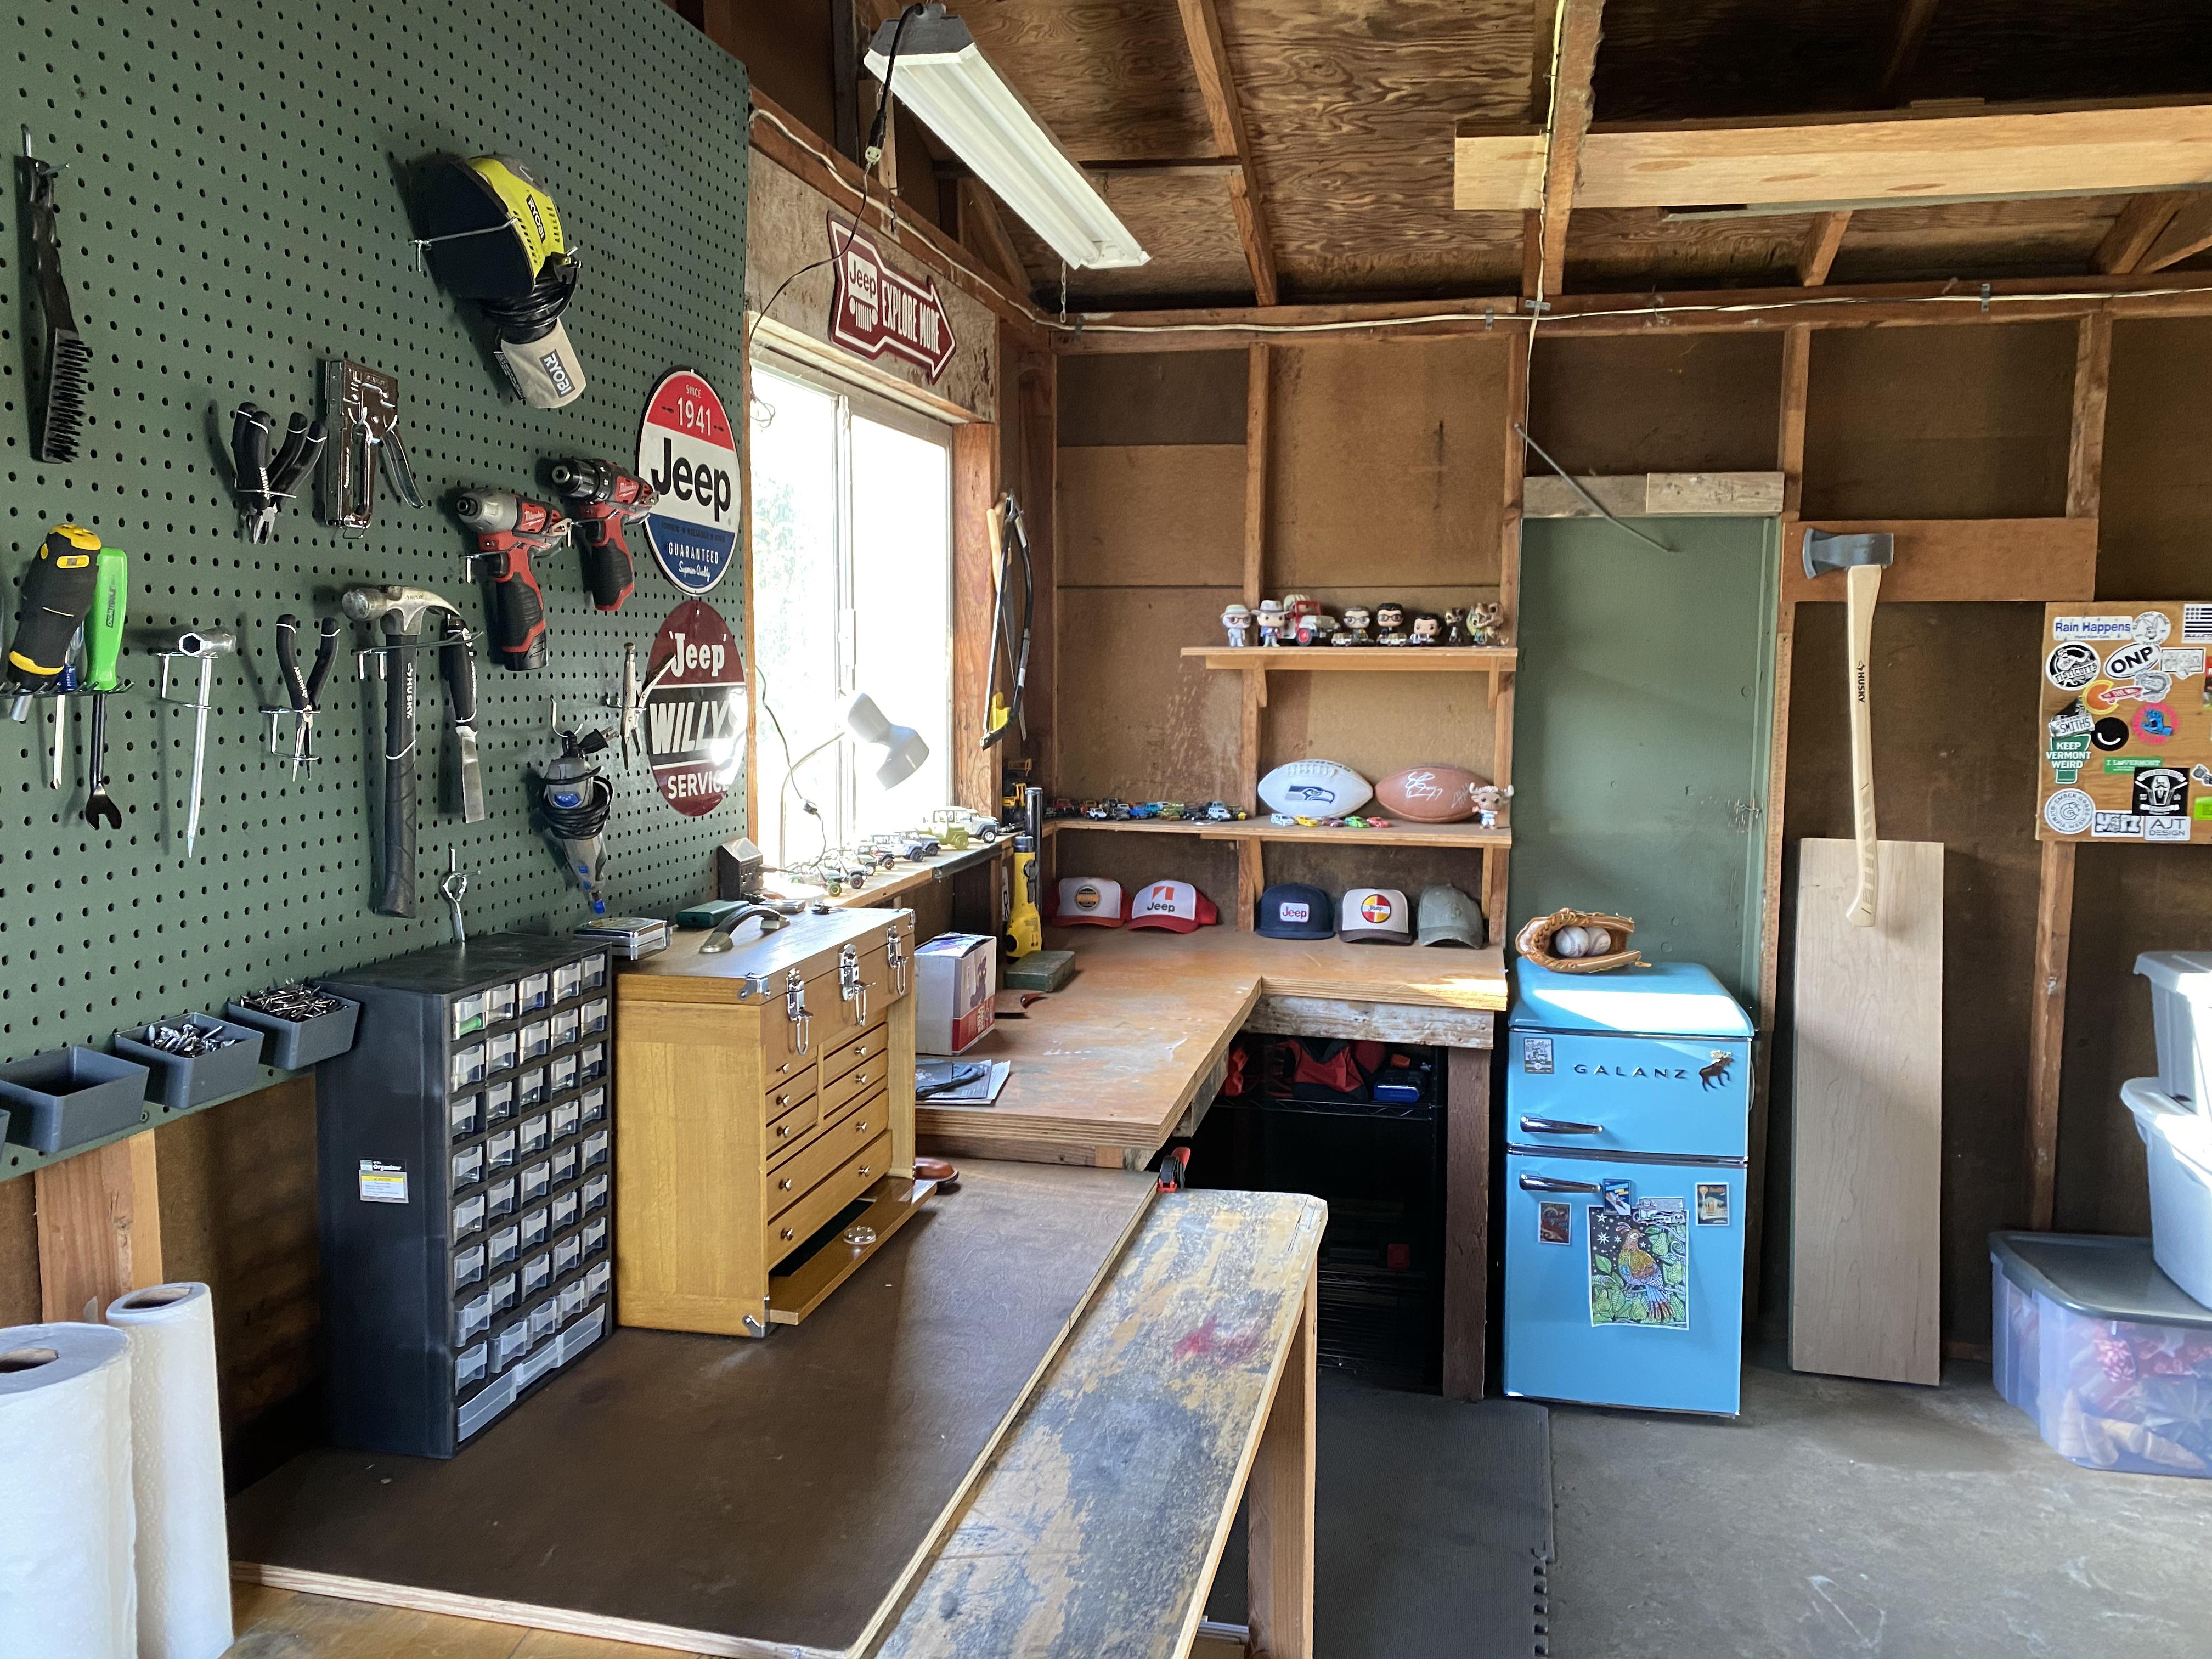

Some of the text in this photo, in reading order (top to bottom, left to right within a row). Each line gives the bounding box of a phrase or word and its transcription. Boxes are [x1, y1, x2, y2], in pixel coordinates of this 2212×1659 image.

[528, 197, 545, 239] RYOBI
[849, 259, 876, 298] Jeep
[882, 279, 940, 355] EXPLORE MORE
[544, 353, 572, 395] RYOBI
[686, 384, 702, 398] SINCE
[678, 397, 711, 436] 1941
[651, 437, 731, 523] Jeep
[669, 541, 719, 565] GUARANTEED
[2056, 622, 2131, 634] Rain Happens
[2111, 646, 2153, 674] ONP
[294, 667, 306, 690] HUSKY
[2055, 662, 2098, 682] FISTICUFFS
[650, 700, 738, 755] WILLY
[2060, 718, 2091, 733] SMITHS
[2046, 751, 2091, 759] VERMONT
[2057, 742, 2081, 750] KEEP
[2051, 760, 2084, 769] WEIRD
[2150, 818, 2186, 830] AJT
[1147, 902, 1175, 912] Jeep
[1282, 906, 1307, 919] Jeep
[1573, 1064, 1687, 1079] GALANZ
